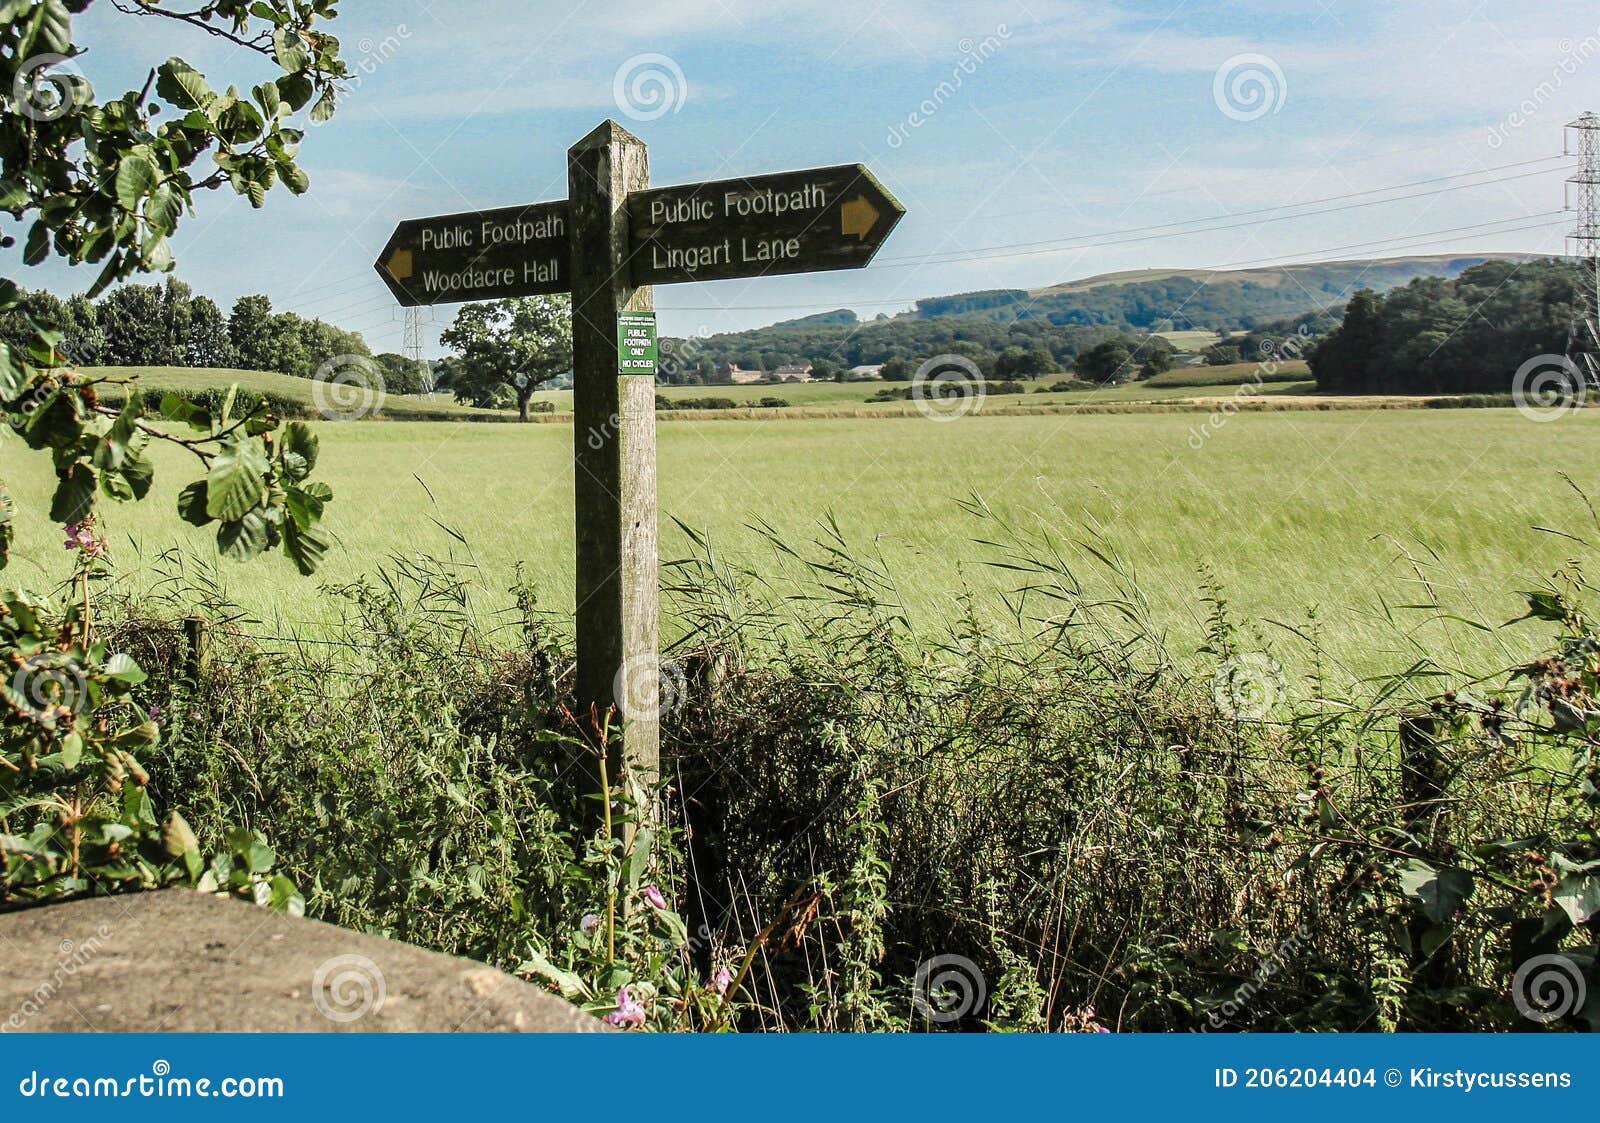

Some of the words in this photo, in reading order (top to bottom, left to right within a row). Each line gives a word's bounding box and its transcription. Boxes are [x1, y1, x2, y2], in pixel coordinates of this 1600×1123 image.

[651, 196, 714, 225] Public
[724, 183, 826, 217] Footpath
[422, 225, 473, 251] Public
[482, 214, 564, 245] Footpath
[652, 239, 731, 273] Lingart
[742, 237, 800, 263] Lane
[423, 267, 515, 293] Woodacre
[524, 258, 558, 284] Hall
[623, 338, 652, 347] FOOTPATH
[627, 328, 647, 337] PUBLIC
[630, 347, 645, 356] ONLY
[622, 360, 631, 368] NO
[632, 360, 654, 368] CYCLES
